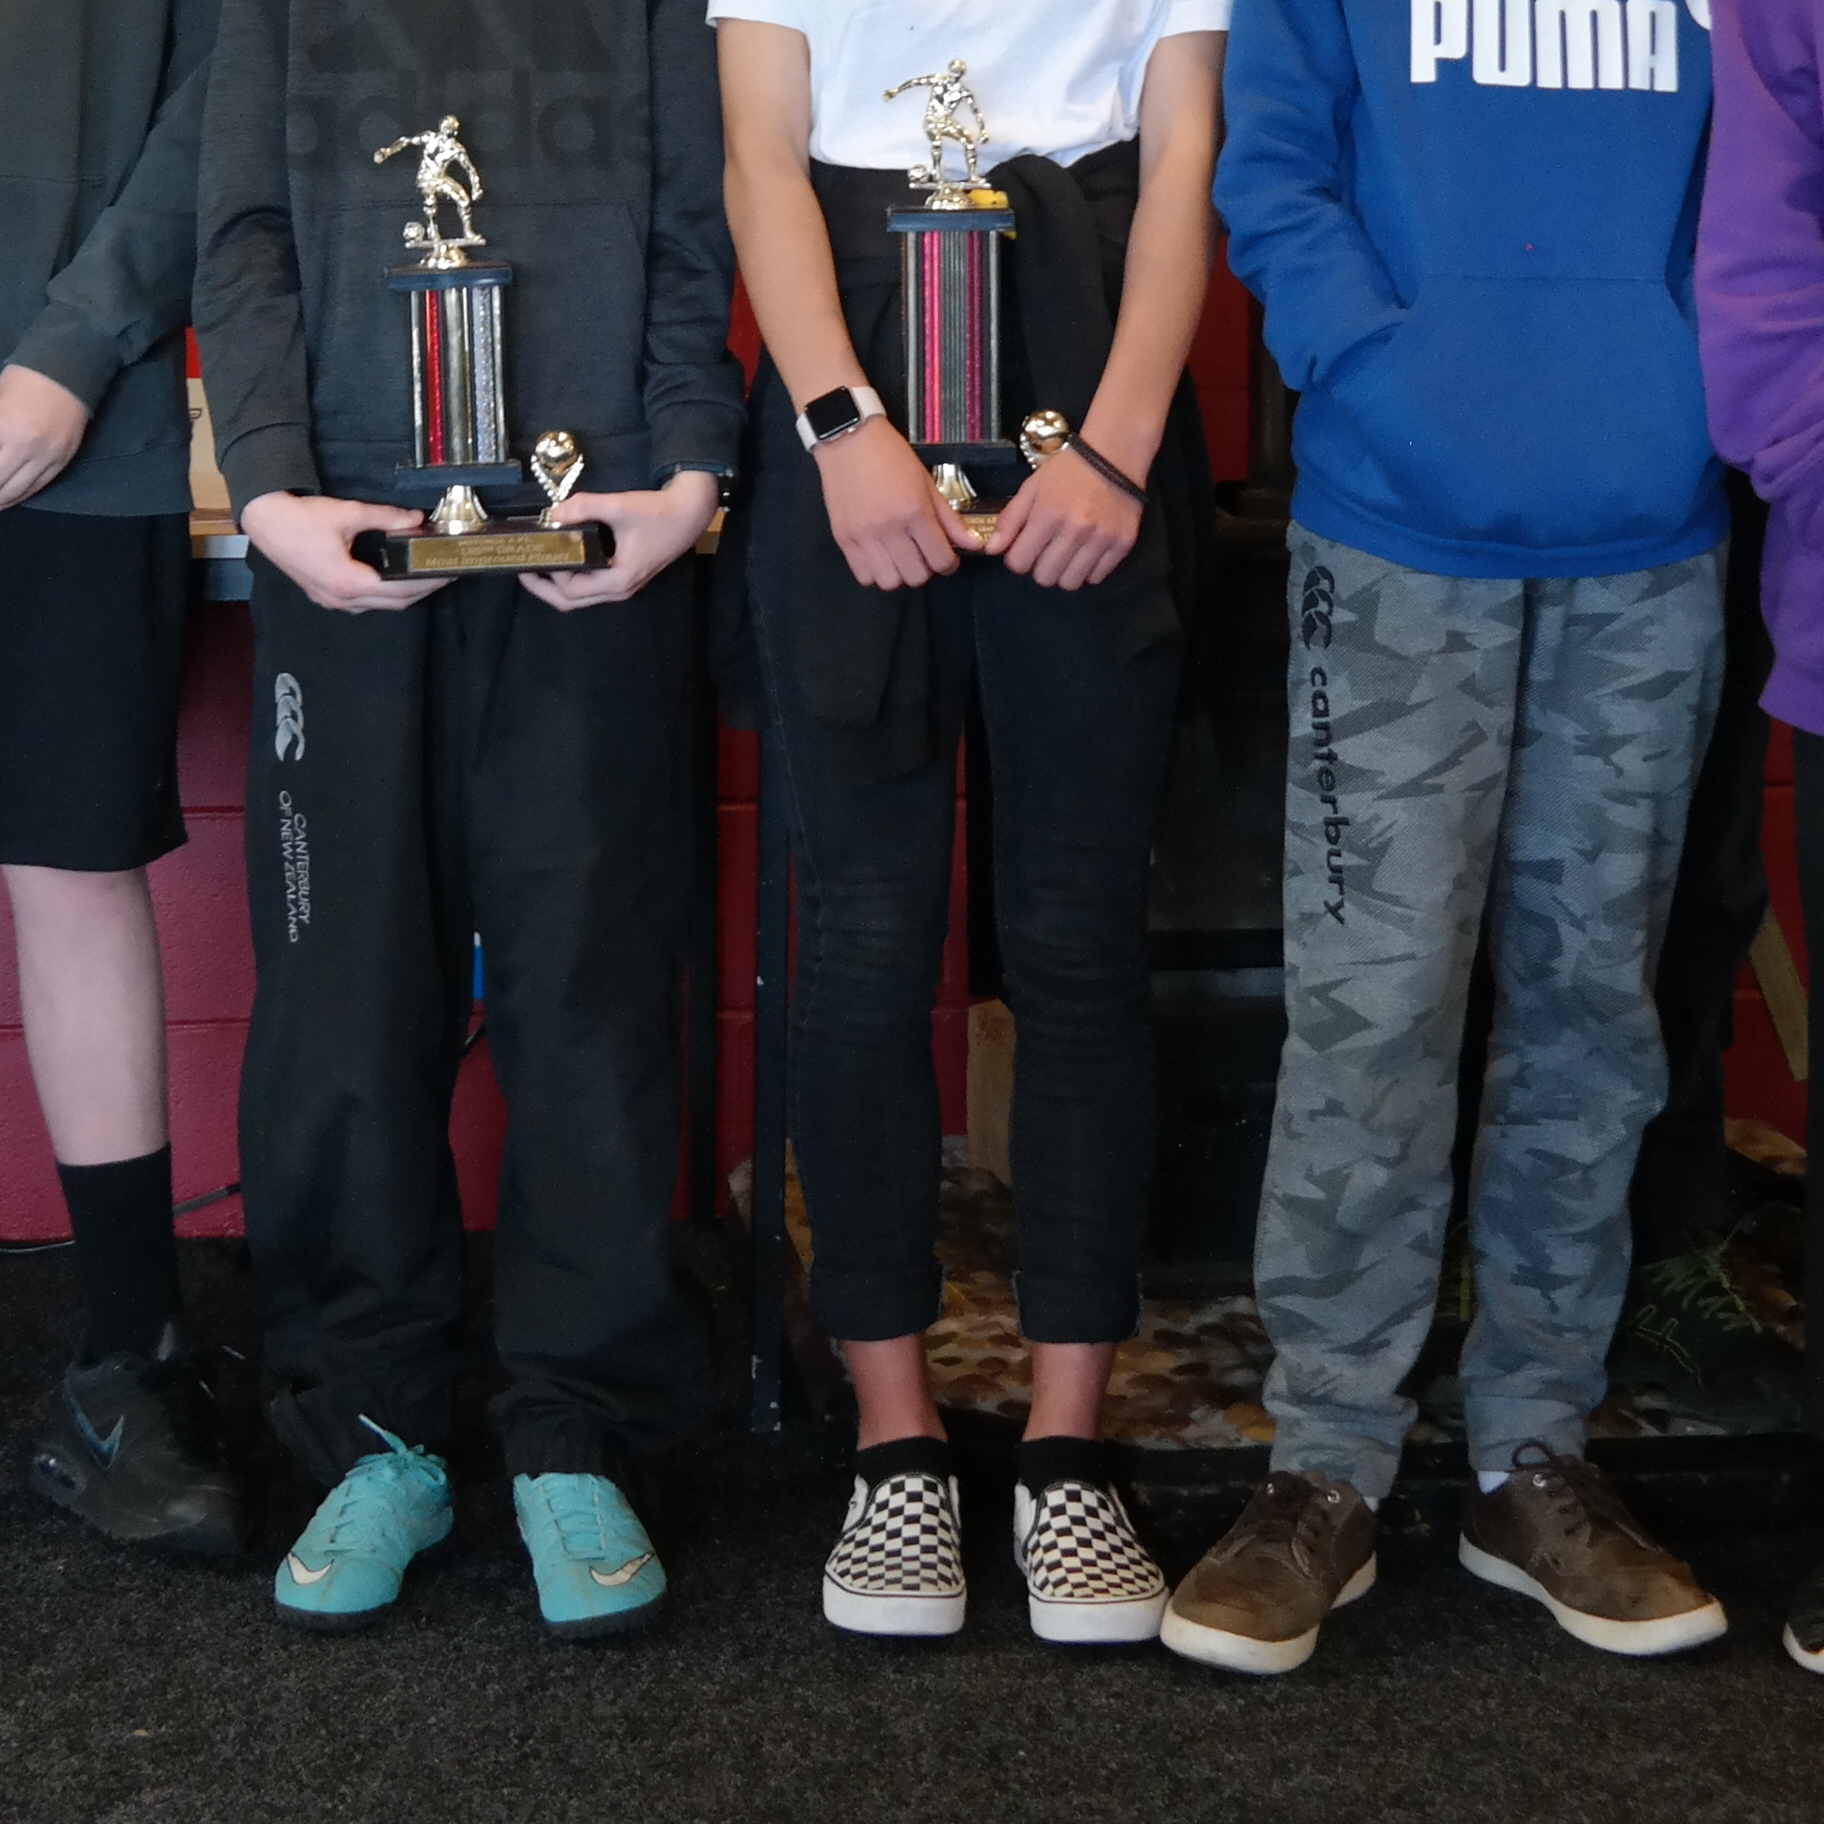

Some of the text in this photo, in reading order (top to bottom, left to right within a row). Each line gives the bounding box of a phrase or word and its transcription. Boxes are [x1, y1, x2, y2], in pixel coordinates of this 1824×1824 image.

[460, 553, 527, 566] Improved
[1308, 665, 1350, 925] canterbury
[279, 789, 299, 944] OF NEW ZEALAND
[293, 812, 312, 925] CANTERBURY
